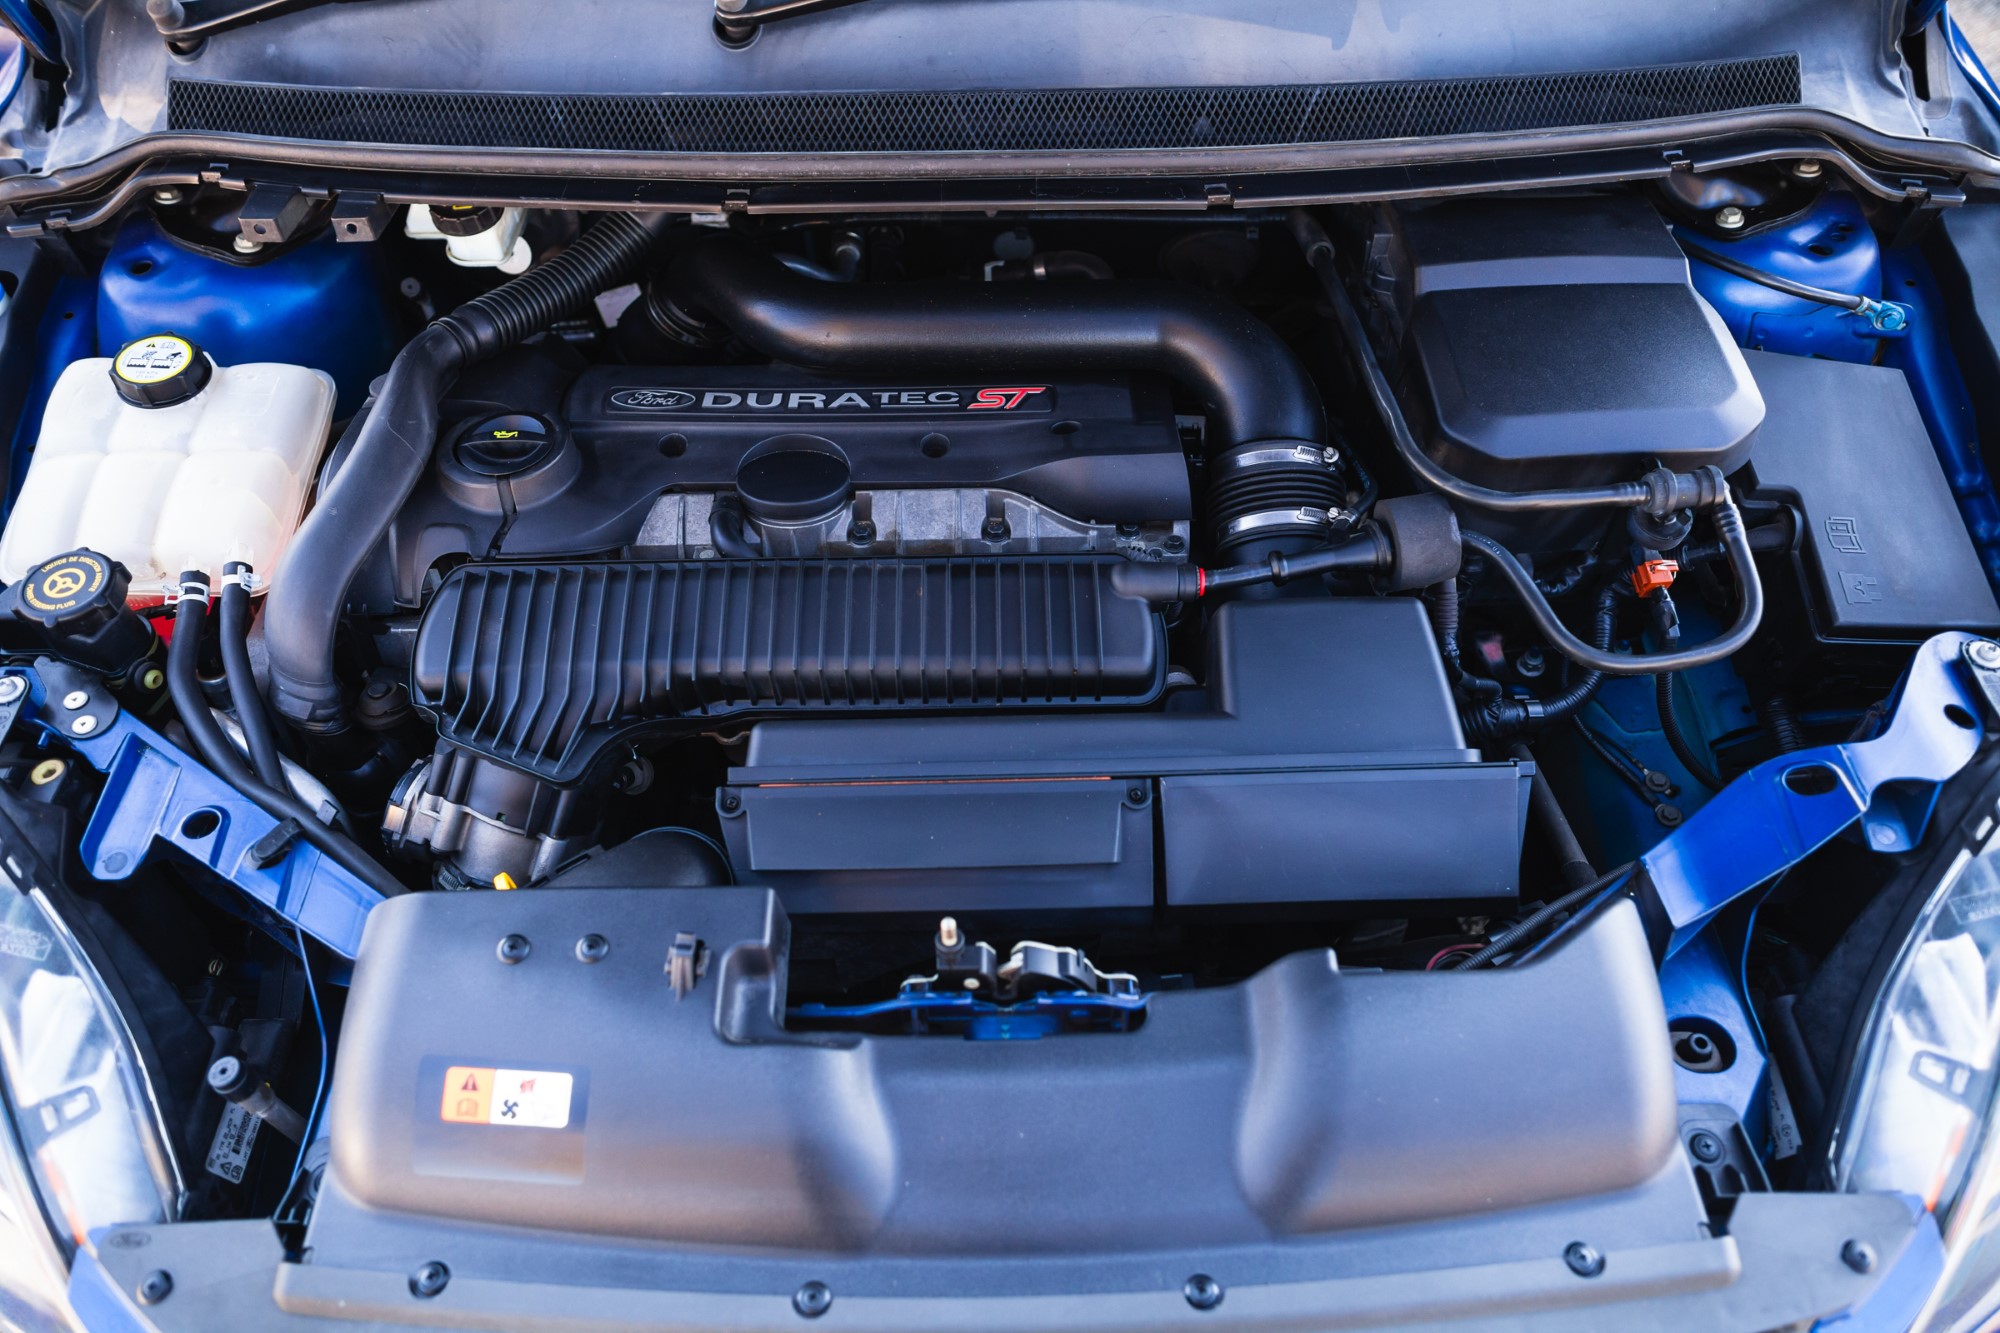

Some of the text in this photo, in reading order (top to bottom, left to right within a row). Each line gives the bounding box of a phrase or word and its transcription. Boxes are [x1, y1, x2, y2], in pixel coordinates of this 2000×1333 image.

[700, 387, 1047, 409] DURATEC ST
[56, 600, 76, 610] FLUID
